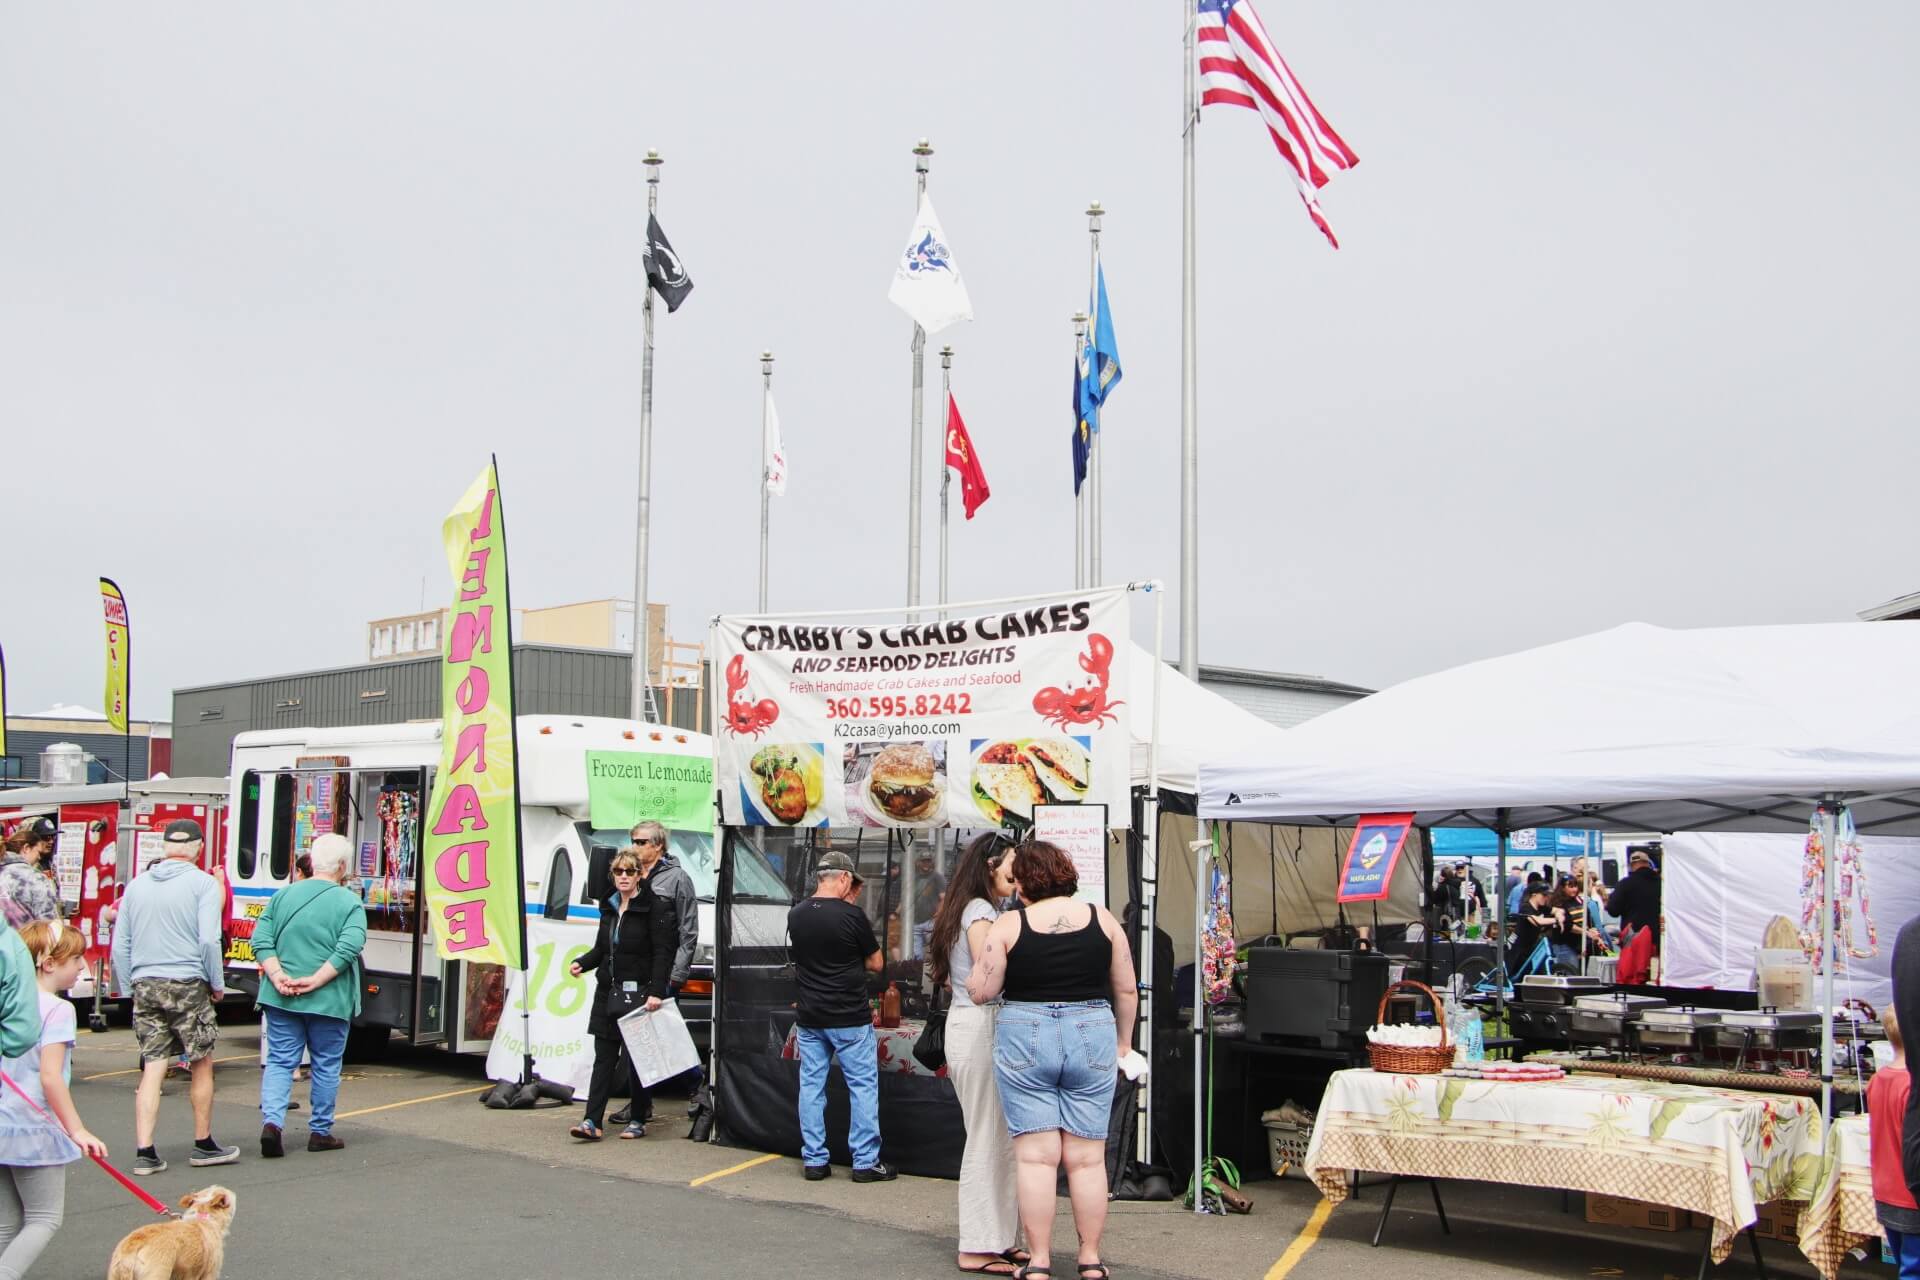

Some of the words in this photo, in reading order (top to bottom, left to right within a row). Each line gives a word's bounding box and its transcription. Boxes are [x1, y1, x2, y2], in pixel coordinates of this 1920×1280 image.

[741, 624, 873, 651] CRABBY'S
[879, 620, 967, 648] CRAB
[975, 602, 1090, 641] CAKES
[792, 657, 832, 673] AND
[833, 653, 921, 673] SEAFOOD
[924, 645, 1016, 670] DELIGHTS
[790, 681, 815, 694] Fresh
[816, 679, 873, 693] Handmade
[877, 677, 903, 690] Crab
[907, 675, 940, 689] Cakes
[943, 673, 966, 687] and
[969, 670, 1021, 686] Seafood
[826, 693, 972, 719] 360.595.8242
[834, 721, 961, 741] K2casa@yahoo.com
[592, 758, 643, 779] Frozen
[648, 762, 713, 784] Lemonade
[502, 1032, 582, 1058] happiness
